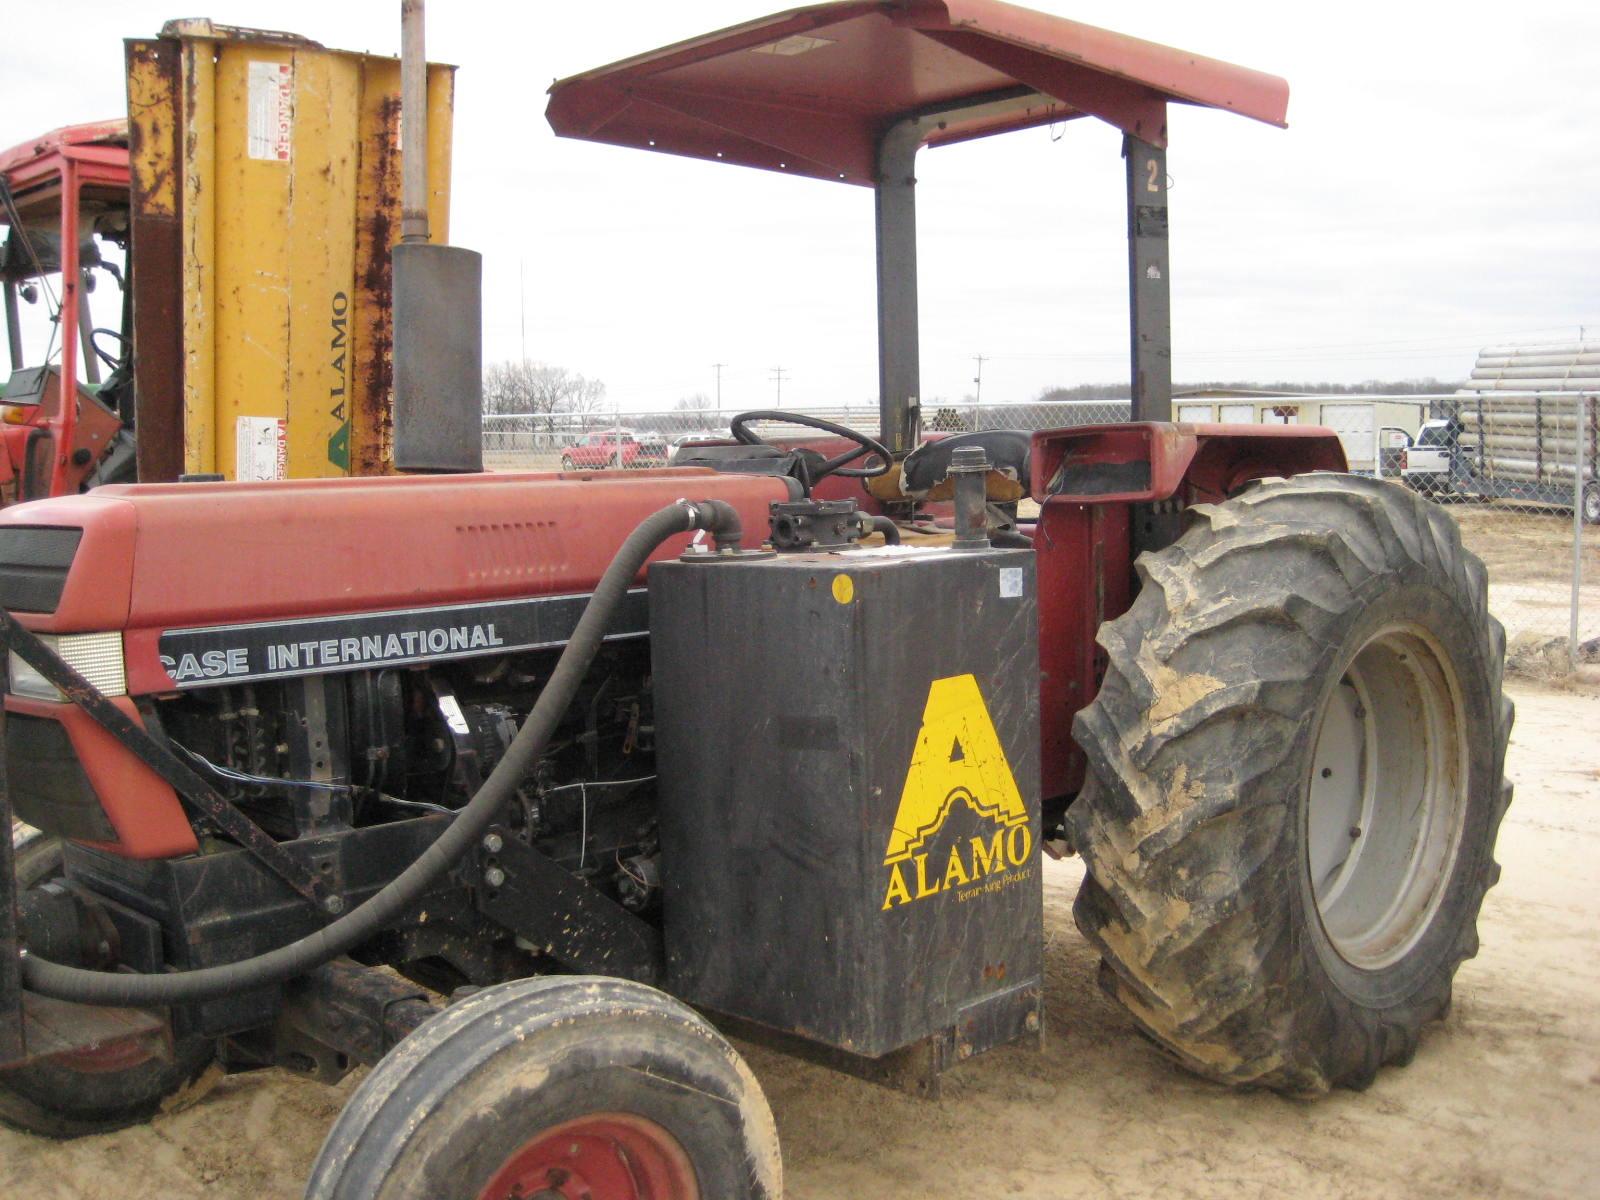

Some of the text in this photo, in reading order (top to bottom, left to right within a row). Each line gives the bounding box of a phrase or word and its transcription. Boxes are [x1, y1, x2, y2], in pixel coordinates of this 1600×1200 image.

[1146, 159, 1159, 192] 2
[331, 291, 348, 422] ALAMO
[268, 623, 503, 671] INTERNATIONAL
[881, 823, 1031, 911] ALAMO
